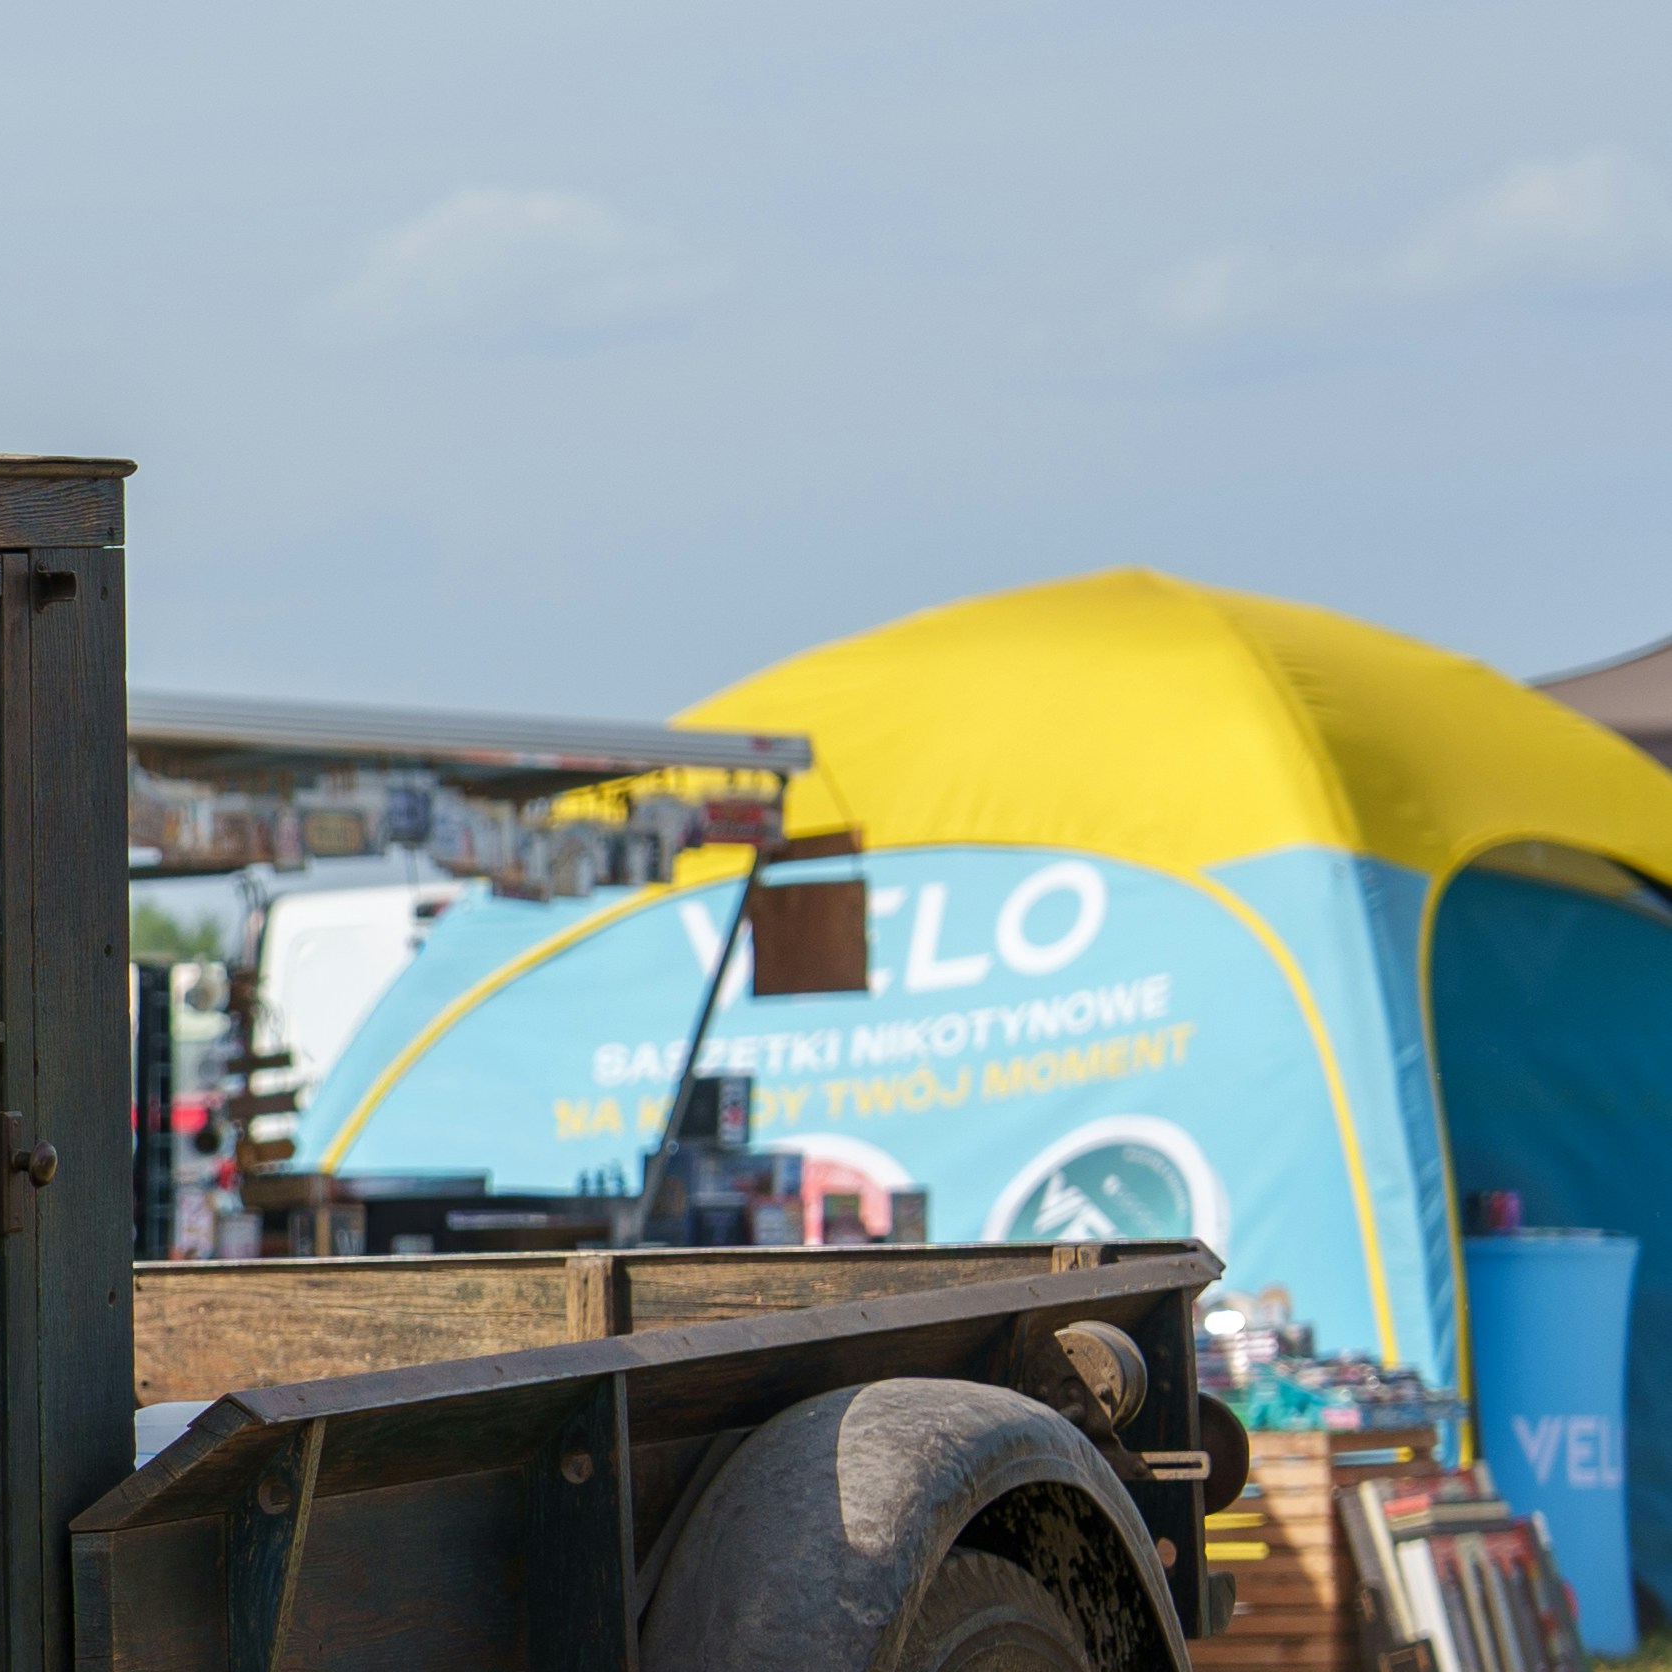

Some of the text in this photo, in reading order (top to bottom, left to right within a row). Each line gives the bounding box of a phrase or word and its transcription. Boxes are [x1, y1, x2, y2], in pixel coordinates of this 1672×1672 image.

[851, 974, 1172, 1067] NIKOTYNOWE
[553, 1094, 626, 1140] NA
[820, 1060, 970, 1119] TWÓJ
[981, 1022, 1197, 1100] MOMENT
